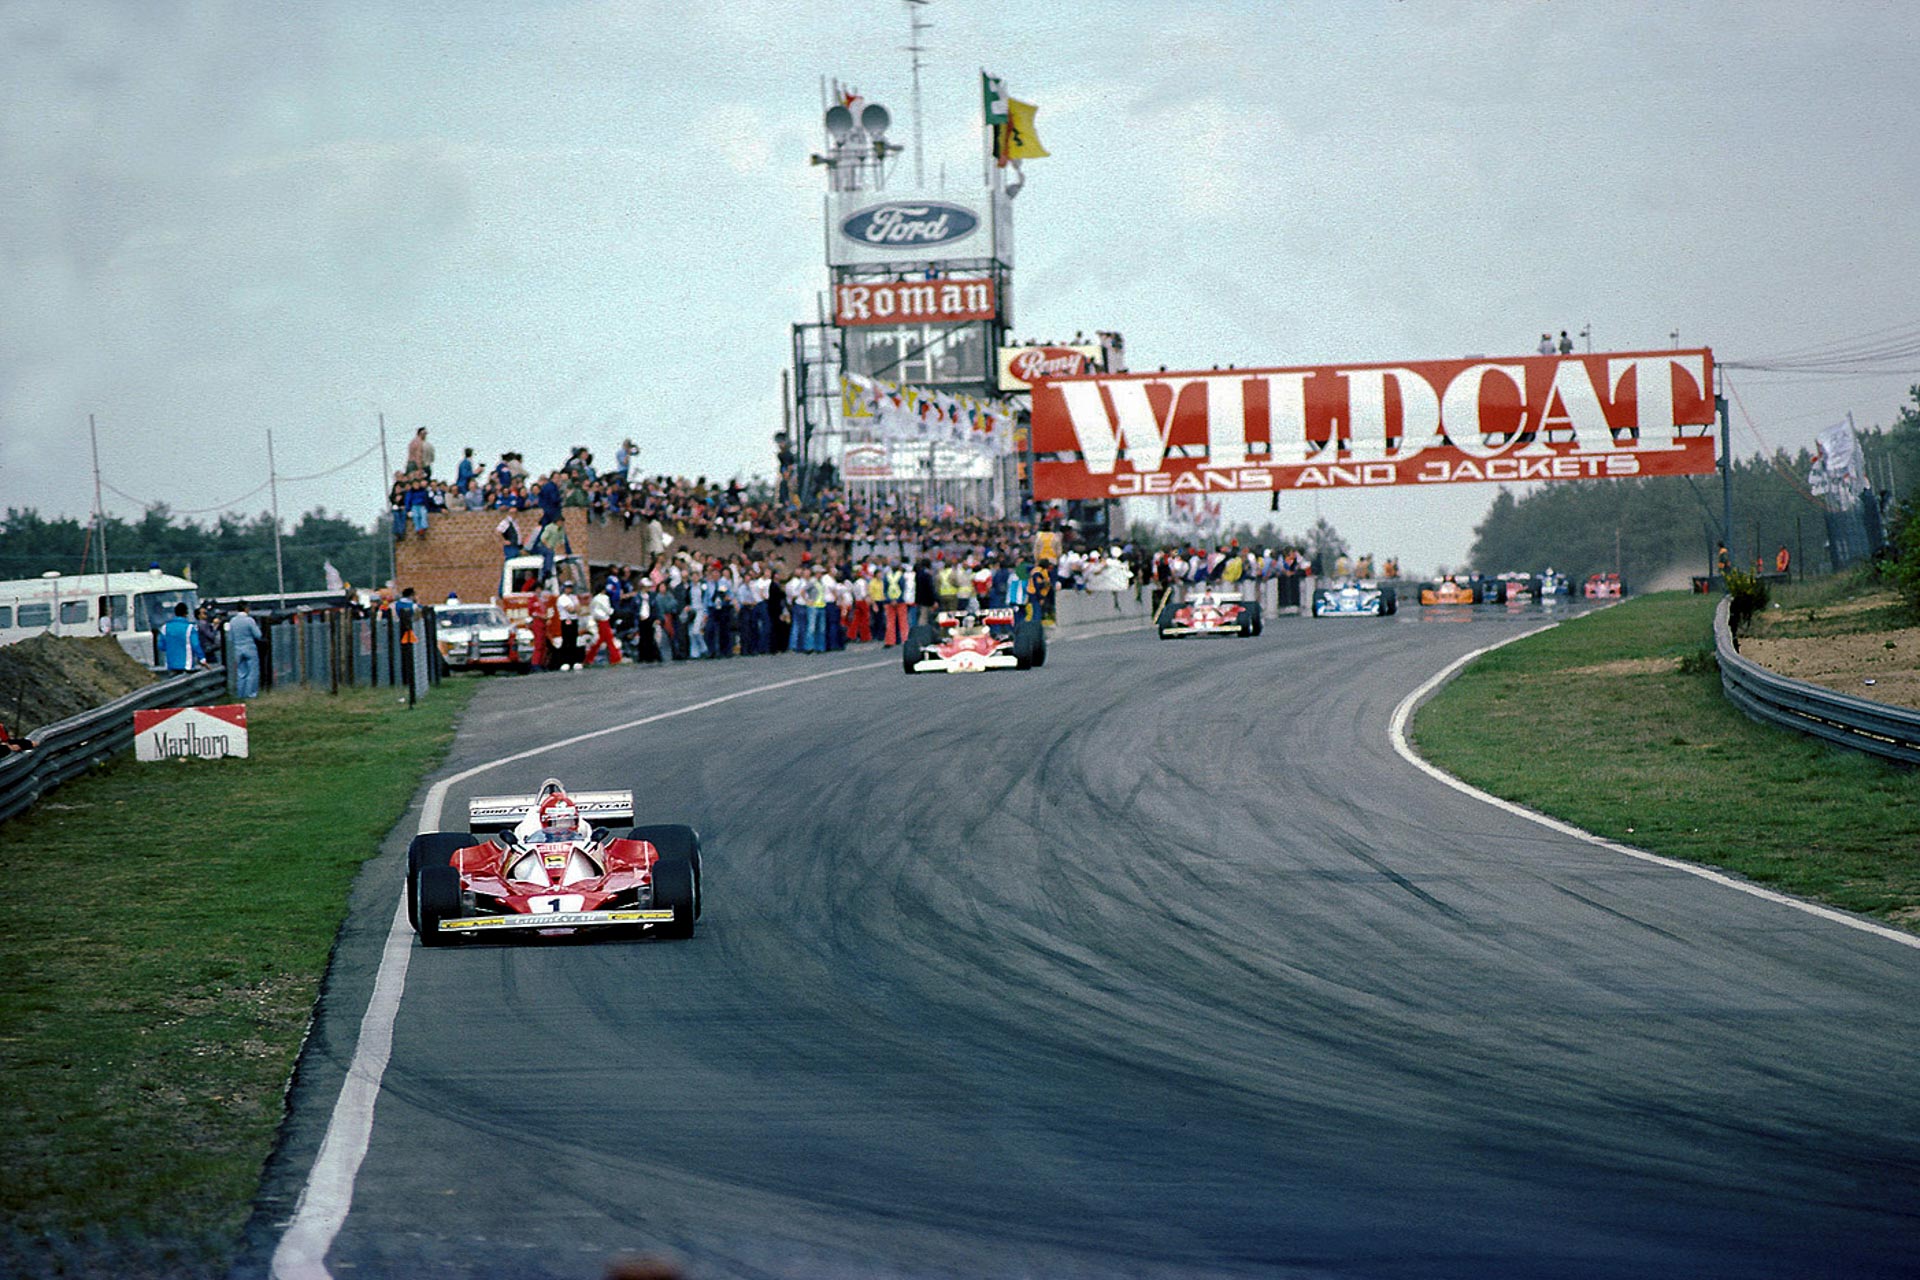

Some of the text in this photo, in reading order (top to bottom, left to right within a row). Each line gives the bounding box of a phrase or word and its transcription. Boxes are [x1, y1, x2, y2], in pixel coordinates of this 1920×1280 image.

[865, 206, 949, 242] Ford
[839, 283, 991, 320] Roman
[1046, 354, 1706, 475] WILDCAT
[1109, 453, 1640, 495] JEANS AND JACKETS
[154, 722, 229, 758] Marlboro
[547, 898, 560, 912] 1
